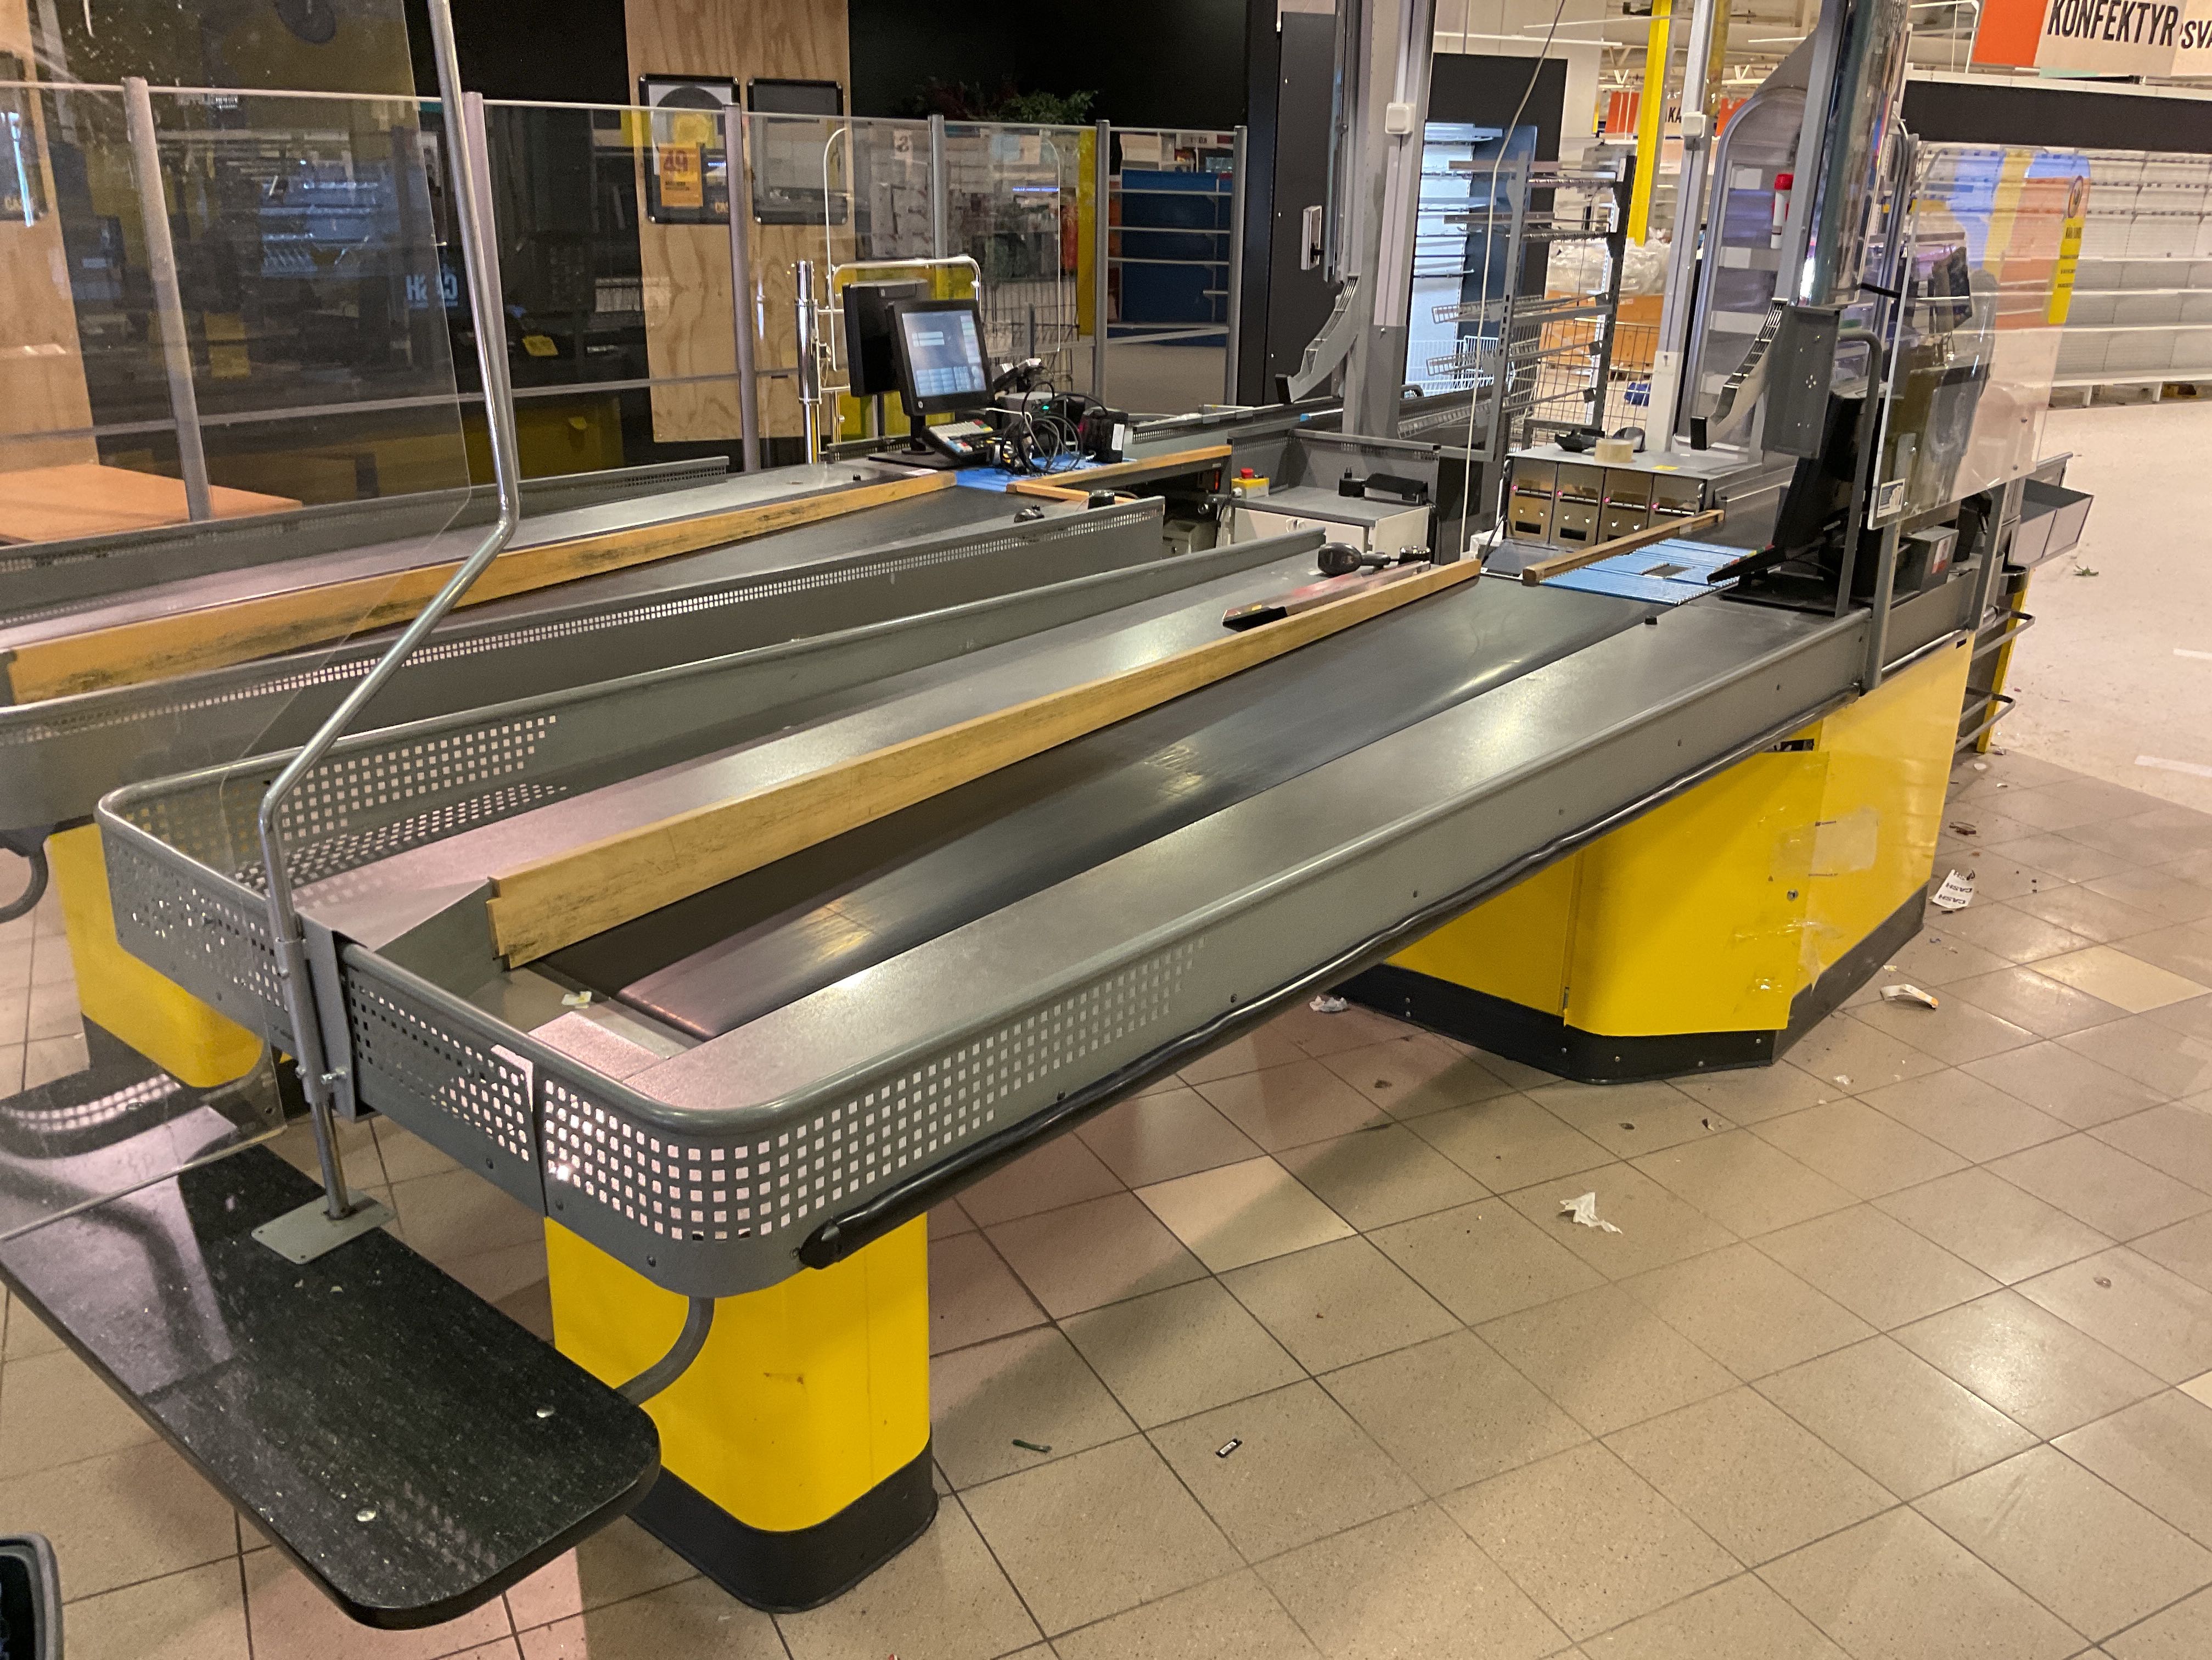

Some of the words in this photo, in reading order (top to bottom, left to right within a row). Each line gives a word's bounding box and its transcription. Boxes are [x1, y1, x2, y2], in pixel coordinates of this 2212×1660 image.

[2047, 0, 2179, 46] KONFEKTYR
[1945, 882, 1973, 893] CASH
[1938, 894, 1966, 905] CASH
